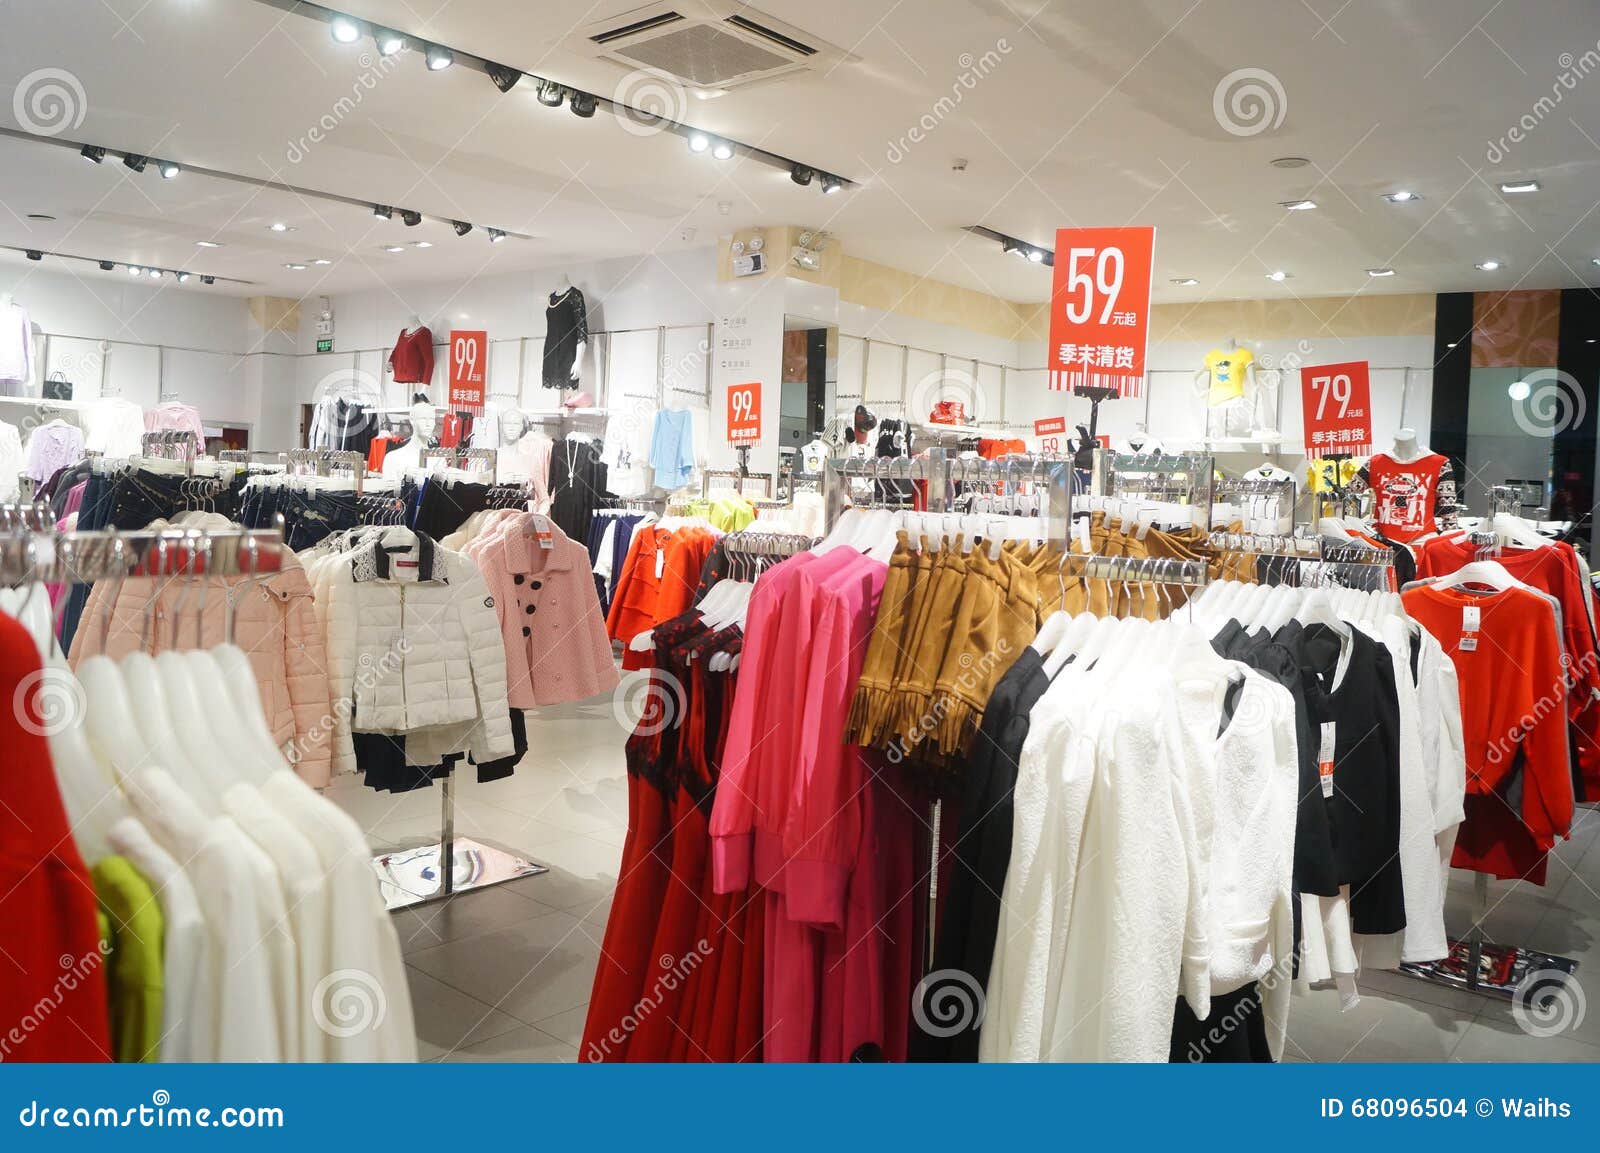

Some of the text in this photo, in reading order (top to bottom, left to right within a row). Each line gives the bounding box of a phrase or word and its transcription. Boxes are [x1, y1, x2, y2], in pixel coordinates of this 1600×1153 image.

[1066, 247, 1137, 326] 59 元起
[455, 337, 477, 381] 99
[1059, 343, 1135, 369] 季末清货
[732, 390, 753, 422] 99
[1311, 374, 1352, 420] 79
[1312, 428, 1365, 444] 季末清货
